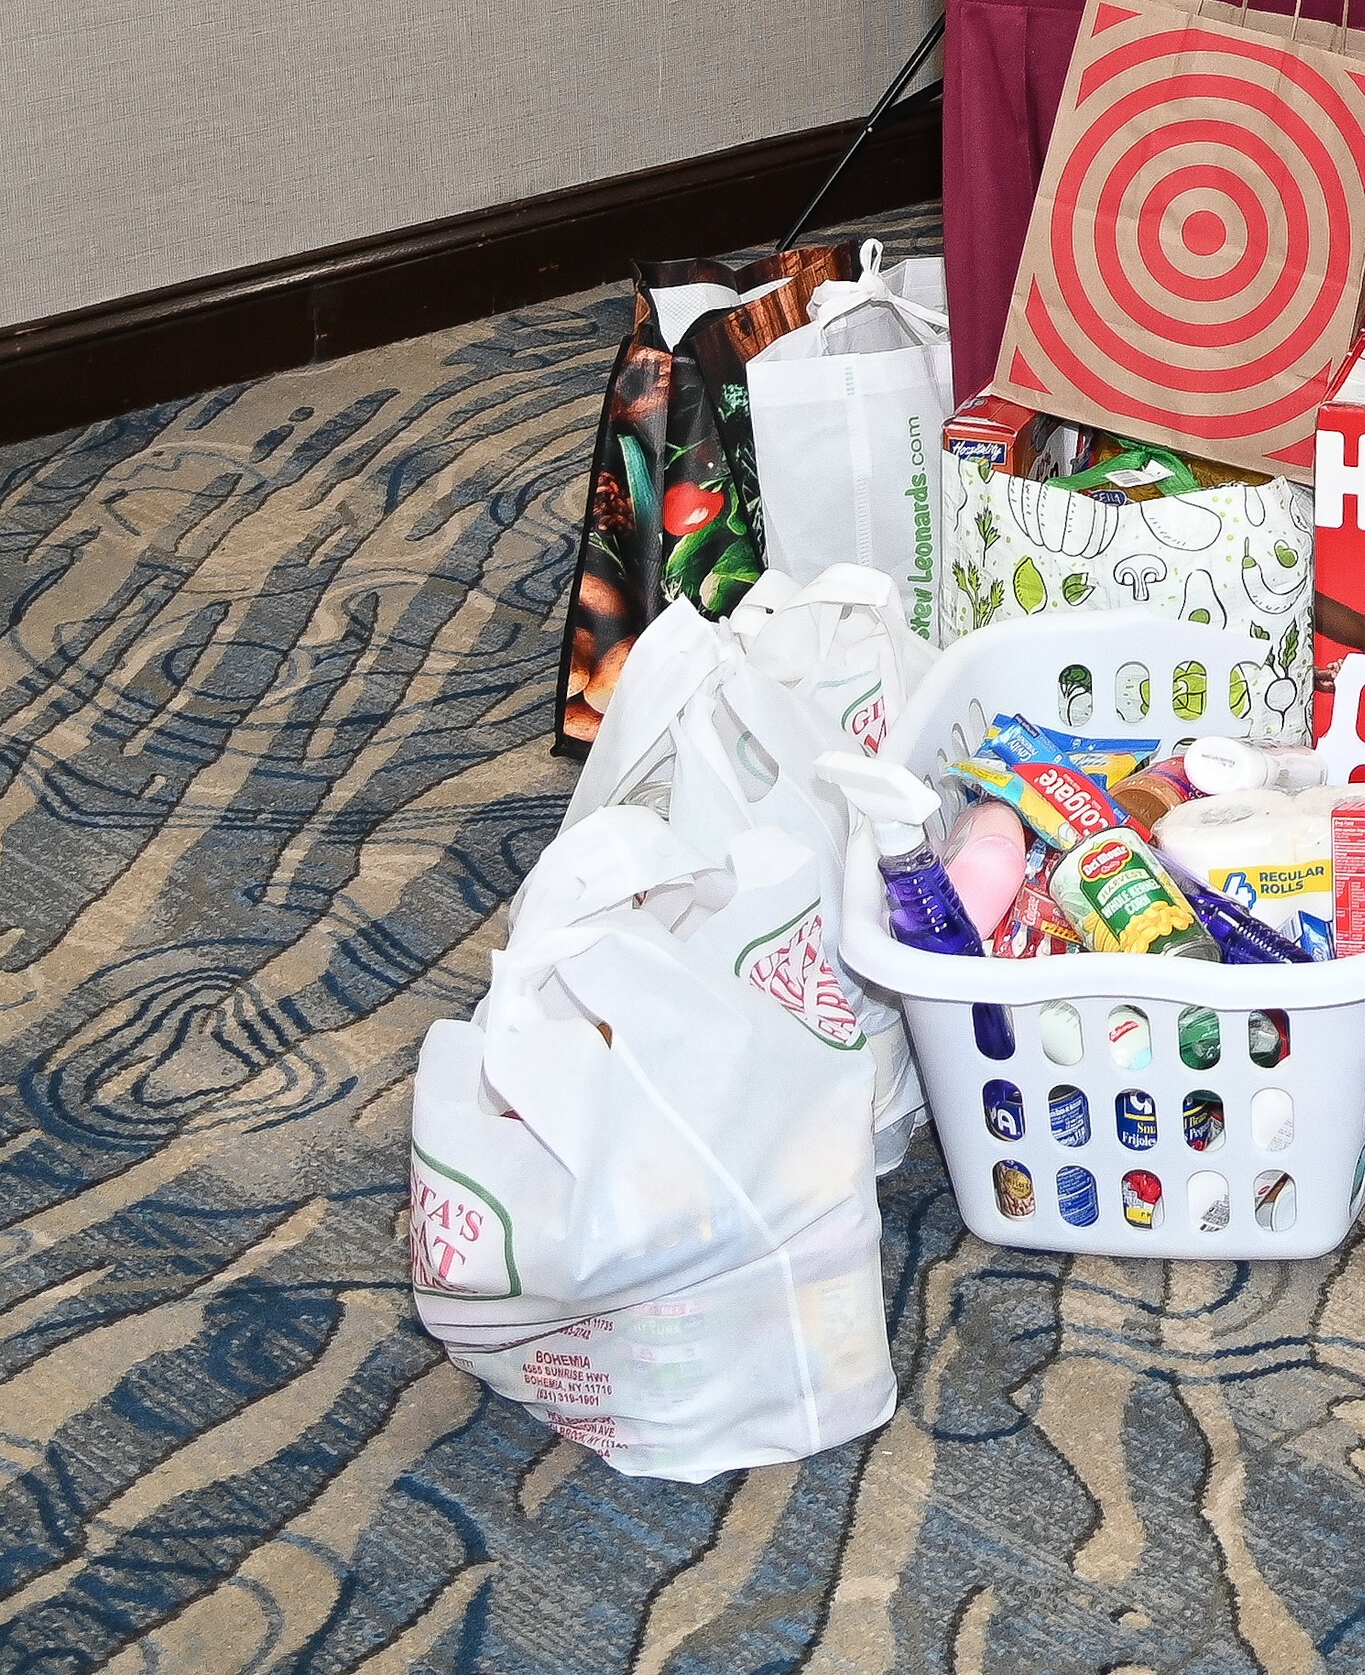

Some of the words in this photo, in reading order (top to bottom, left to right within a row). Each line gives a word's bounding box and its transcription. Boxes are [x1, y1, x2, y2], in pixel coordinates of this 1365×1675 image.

[905, 416, 933, 582] Leonards.com
[1259, 866, 1324, 882] REGULAR
[1261, 881, 1304, 894] ROLLS
[536, 1351, 590, 1368] BOHEMIA
